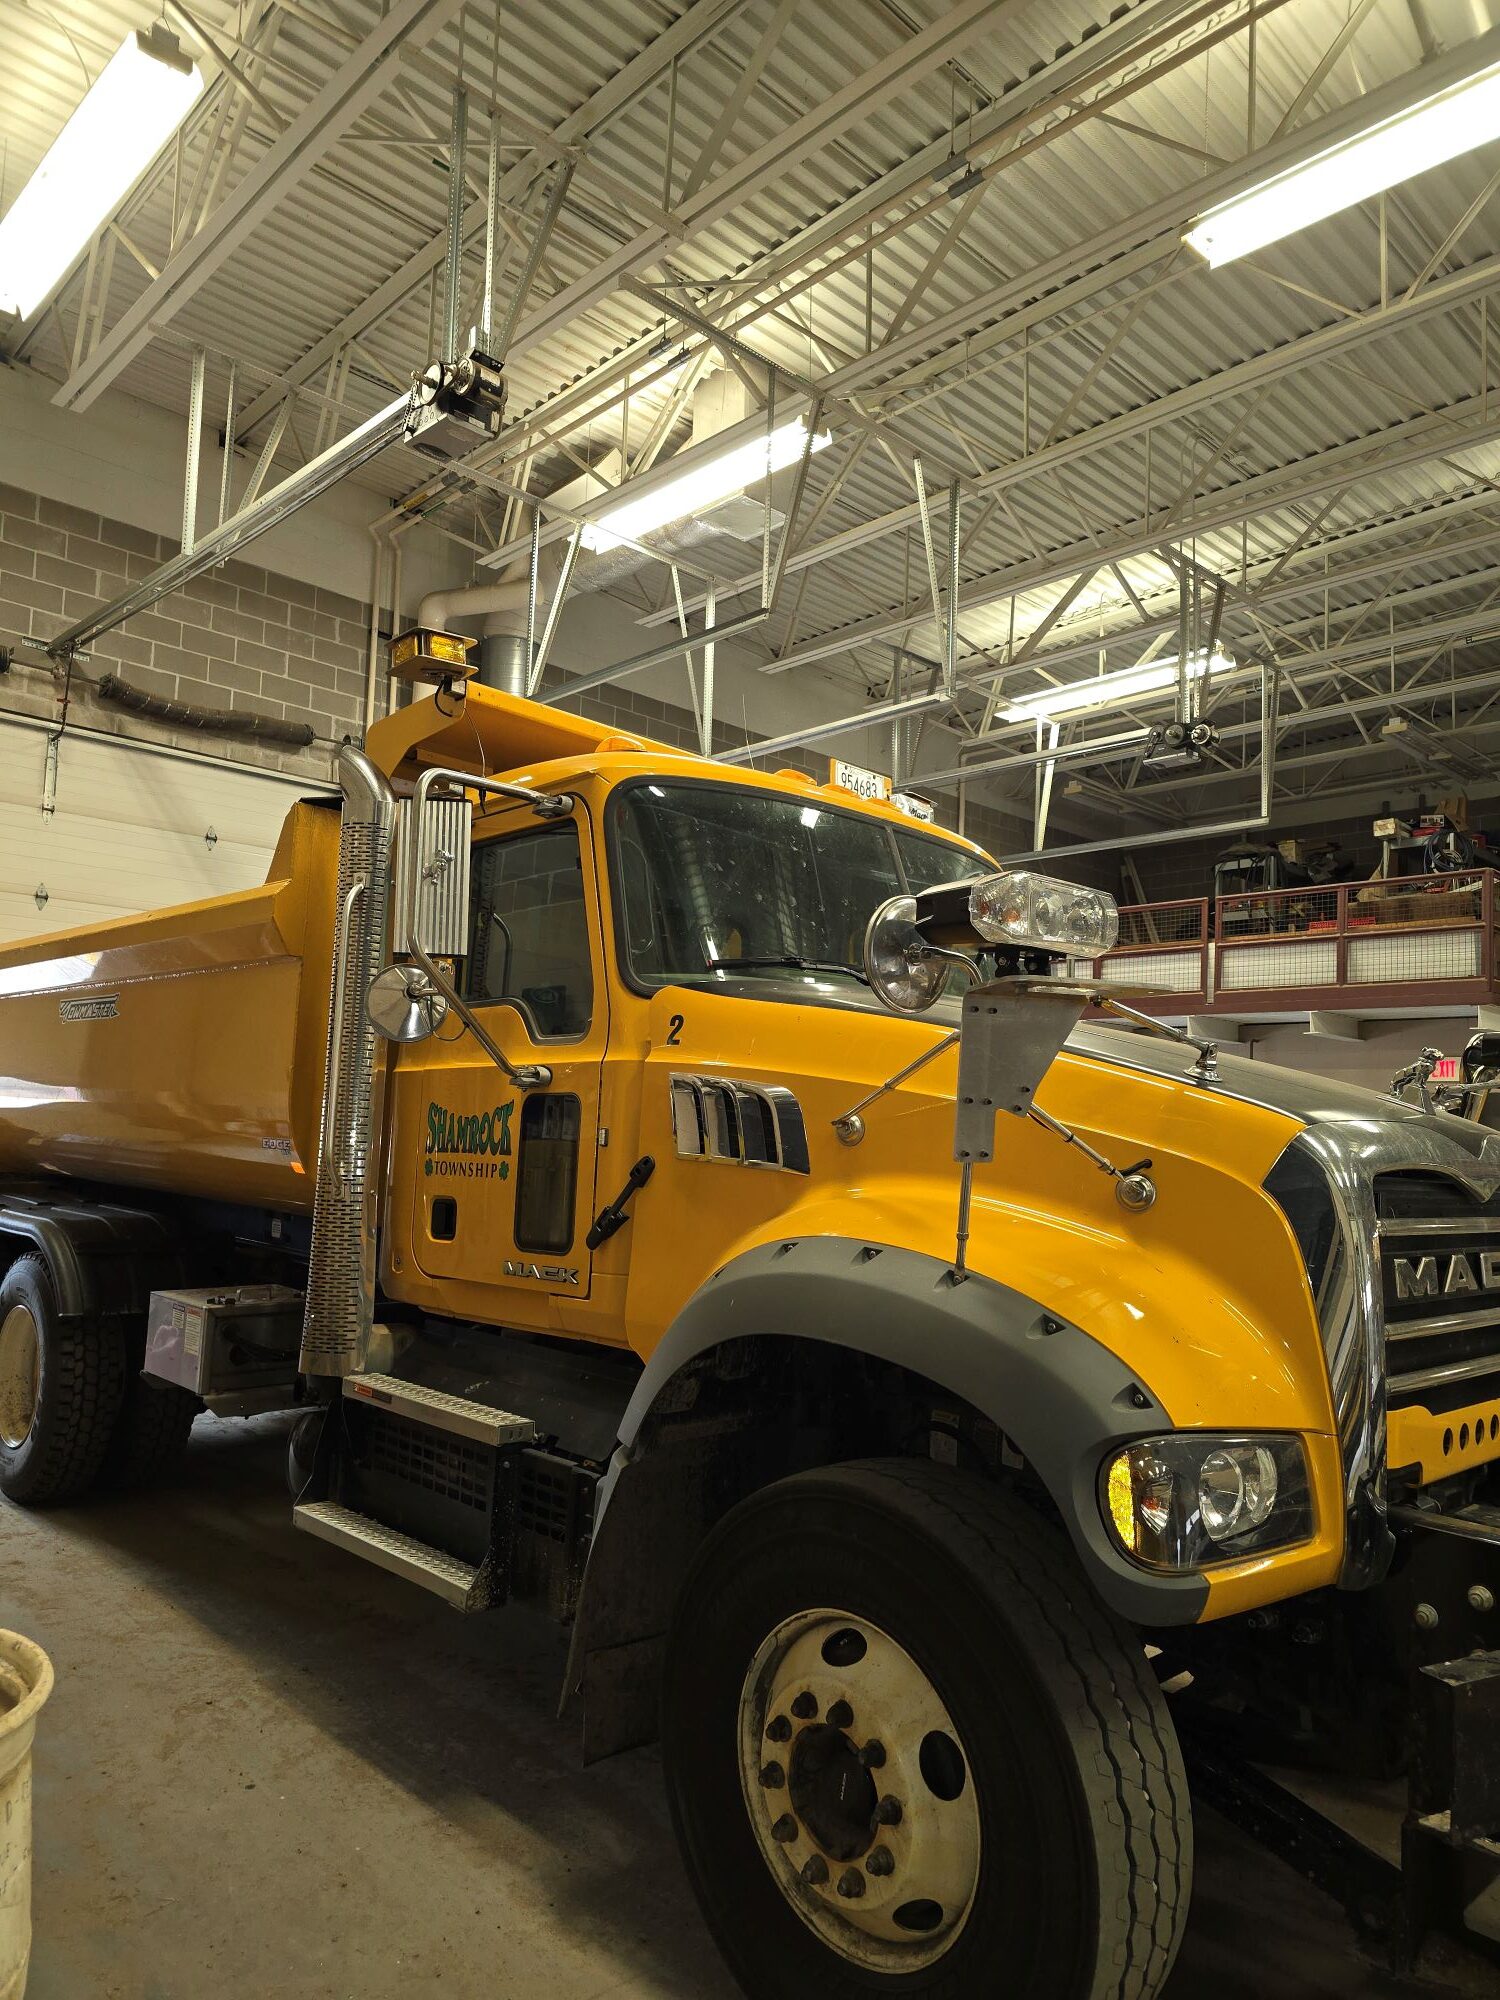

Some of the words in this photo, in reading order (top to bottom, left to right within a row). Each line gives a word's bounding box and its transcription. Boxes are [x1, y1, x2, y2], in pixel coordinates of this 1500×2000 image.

[841, 772, 878, 799] 954683
[666, 1014, 685, 1046] 2
[425, 1099, 514, 1156] SHAMROCK
[262, 1138, 291, 1150] EDGE
[434, 1160, 498, 1178] TOWNSHIP
[503, 1260, 579, 1285] MACK
